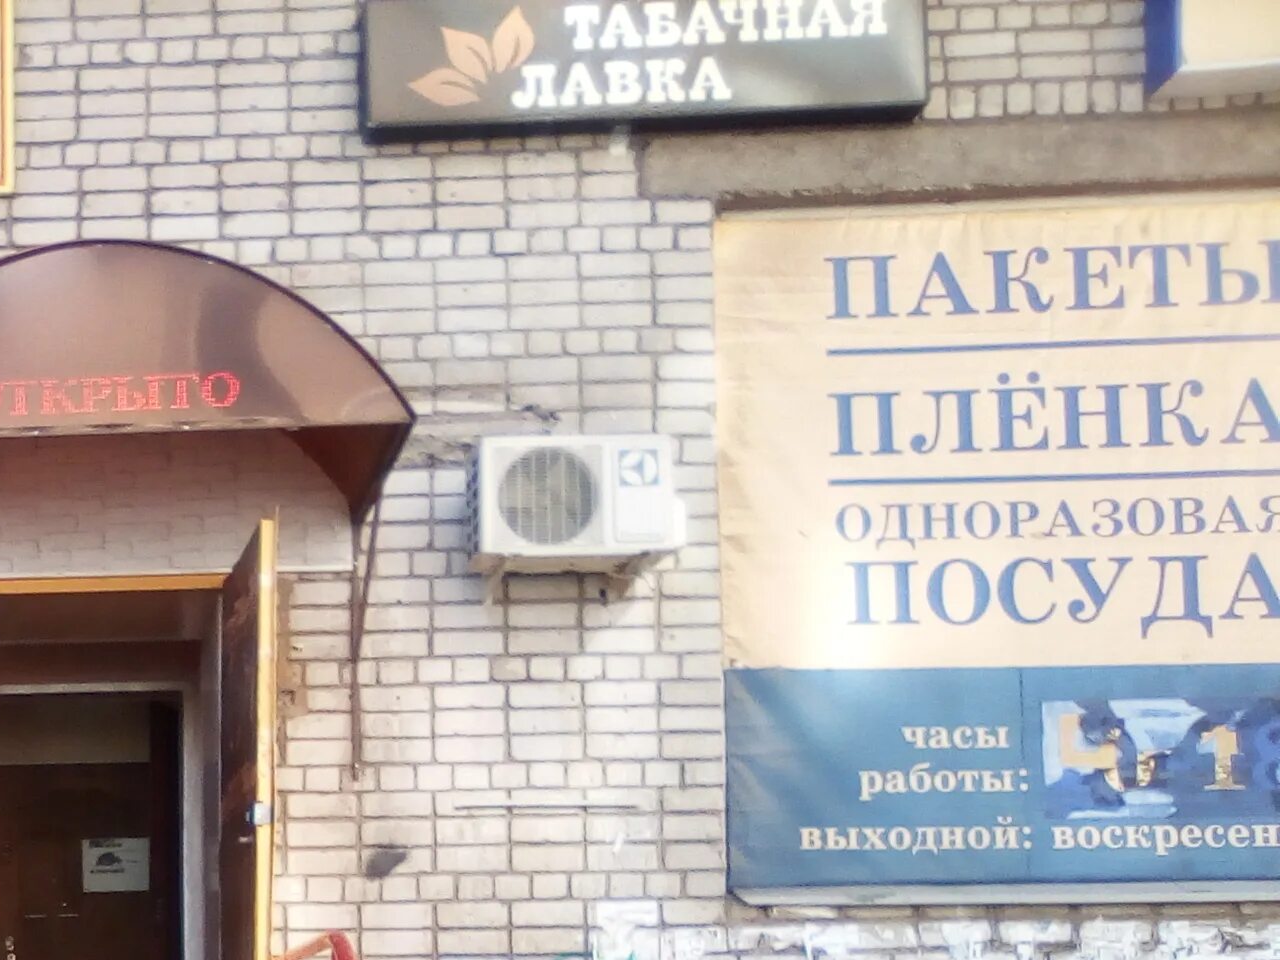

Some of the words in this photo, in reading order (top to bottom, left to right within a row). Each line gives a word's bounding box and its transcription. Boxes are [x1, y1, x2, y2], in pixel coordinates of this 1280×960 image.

[563, 0, 888, 50] ТАБАЧНАЯ
[511, 56, 732, 108] ЛАВКА
[824, 239, 1280, 321] ПАКЕТЫ
[827, 373, 1280, 457] ПЛЁНКА
[846, 552, 1280, 639] ПОСУДА
[902, 725, 1009, 750] часы
[859, 762, 1029, 801] работы:
[799, 816, 1033, 855] выходной:
[1051, 824, 1280, 856] воскресен
